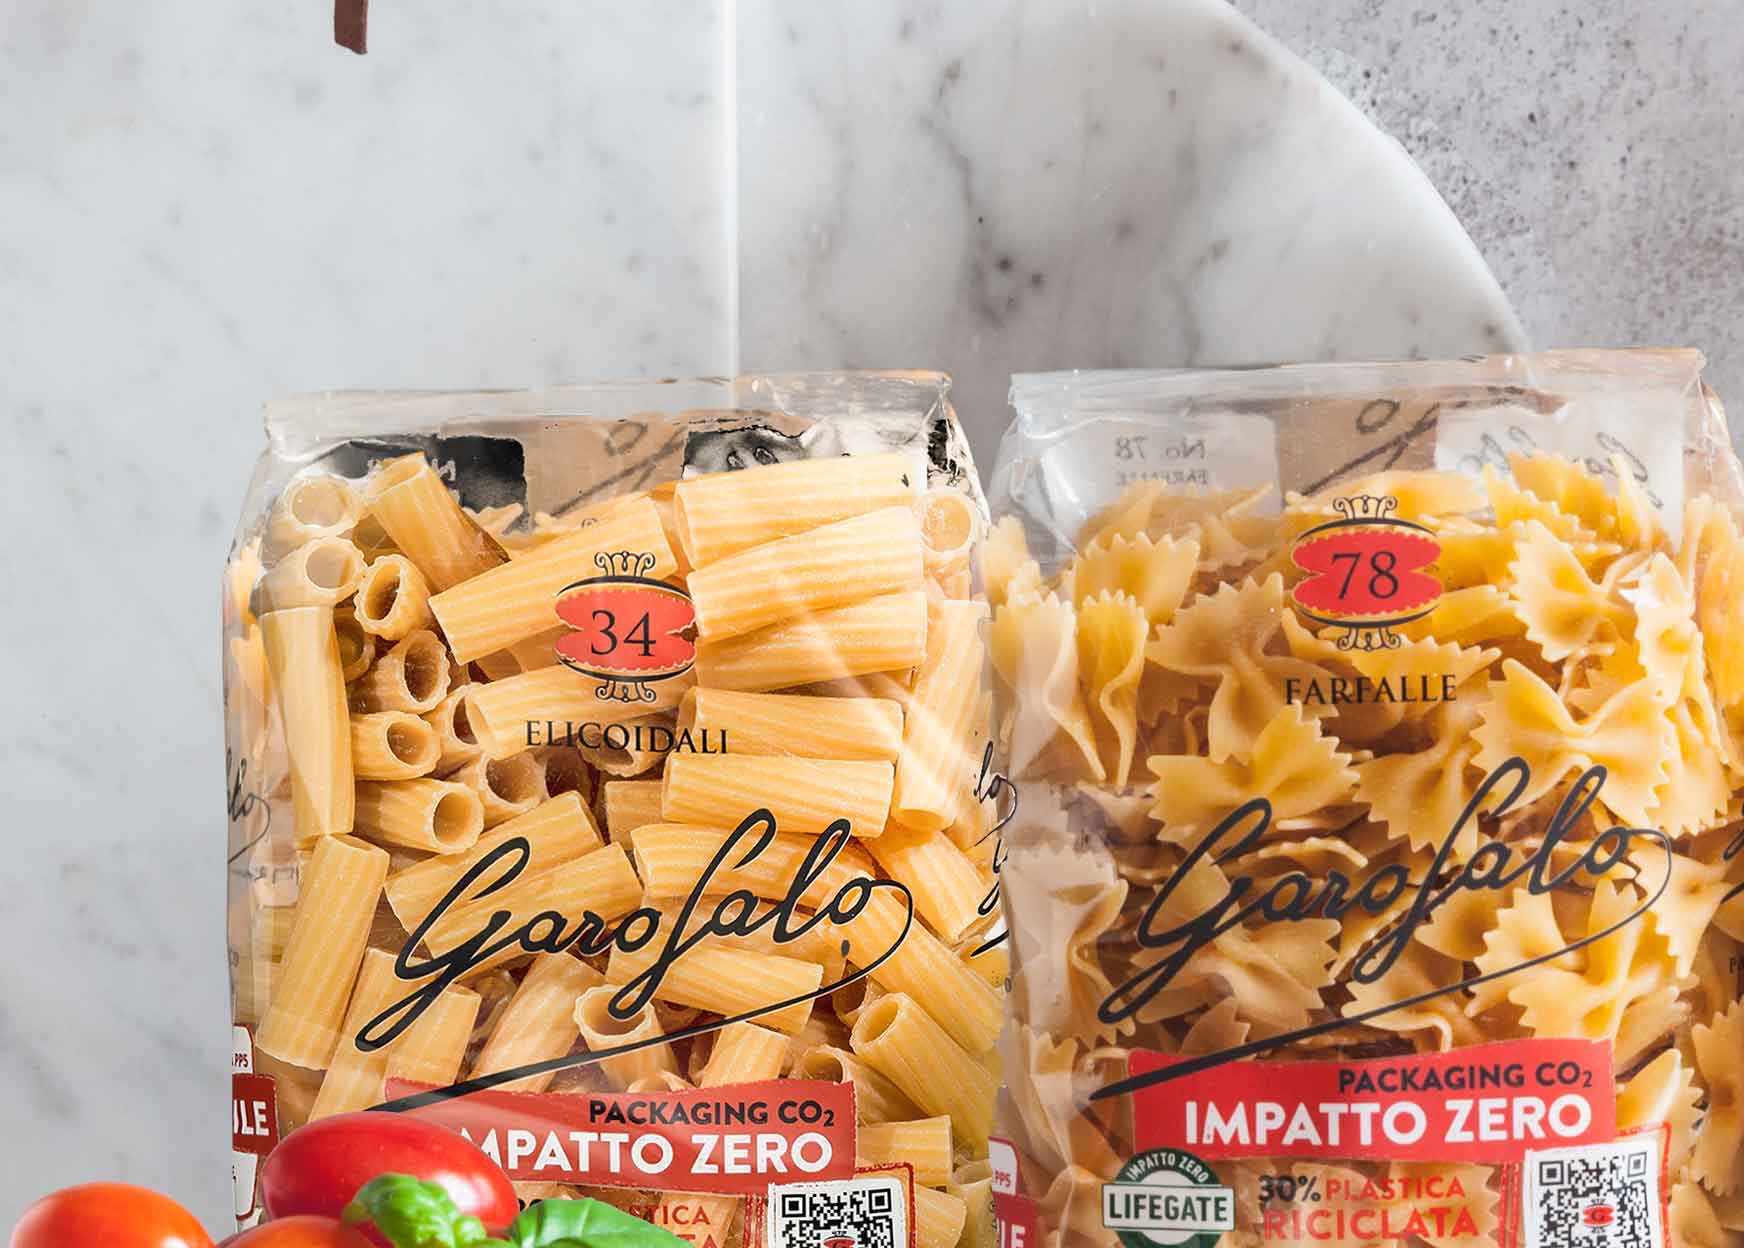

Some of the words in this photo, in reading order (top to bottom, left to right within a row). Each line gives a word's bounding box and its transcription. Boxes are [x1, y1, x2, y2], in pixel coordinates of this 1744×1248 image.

[1332, 550, 1399, 600] 78
[590, 609, 657, 657] 34
[1285, 673, 1457, 706] FARFALLE
[526, 719, 729, 755] ELICOIDALI
[1097, 757, 1672, 1023] Garofalo
[354, 808, 913, 1052] Garofalo
[1338, 1064, 1525, 1093] PACKAGING
[589, 1100, 769, 1126] PACKAGING
[1185, 1101, 1426, 1145] IMPATTO
[1444, 1094, 1592, 1143] ZERO
[690, 1132, 833, 1175] ZERO
[1125, 1152, 1176, 1181] IMPATTO
[1178, 1156, 1209, 1183] ZERO
[1258, 1174, 1321, 1203] 30%
[1327, 1176, 1466, 1202] PLASTICA
[1109, 1193, 1228, 1222] LIFEGATE
[1263, 1206, 1480, 1241] RICICLATA
